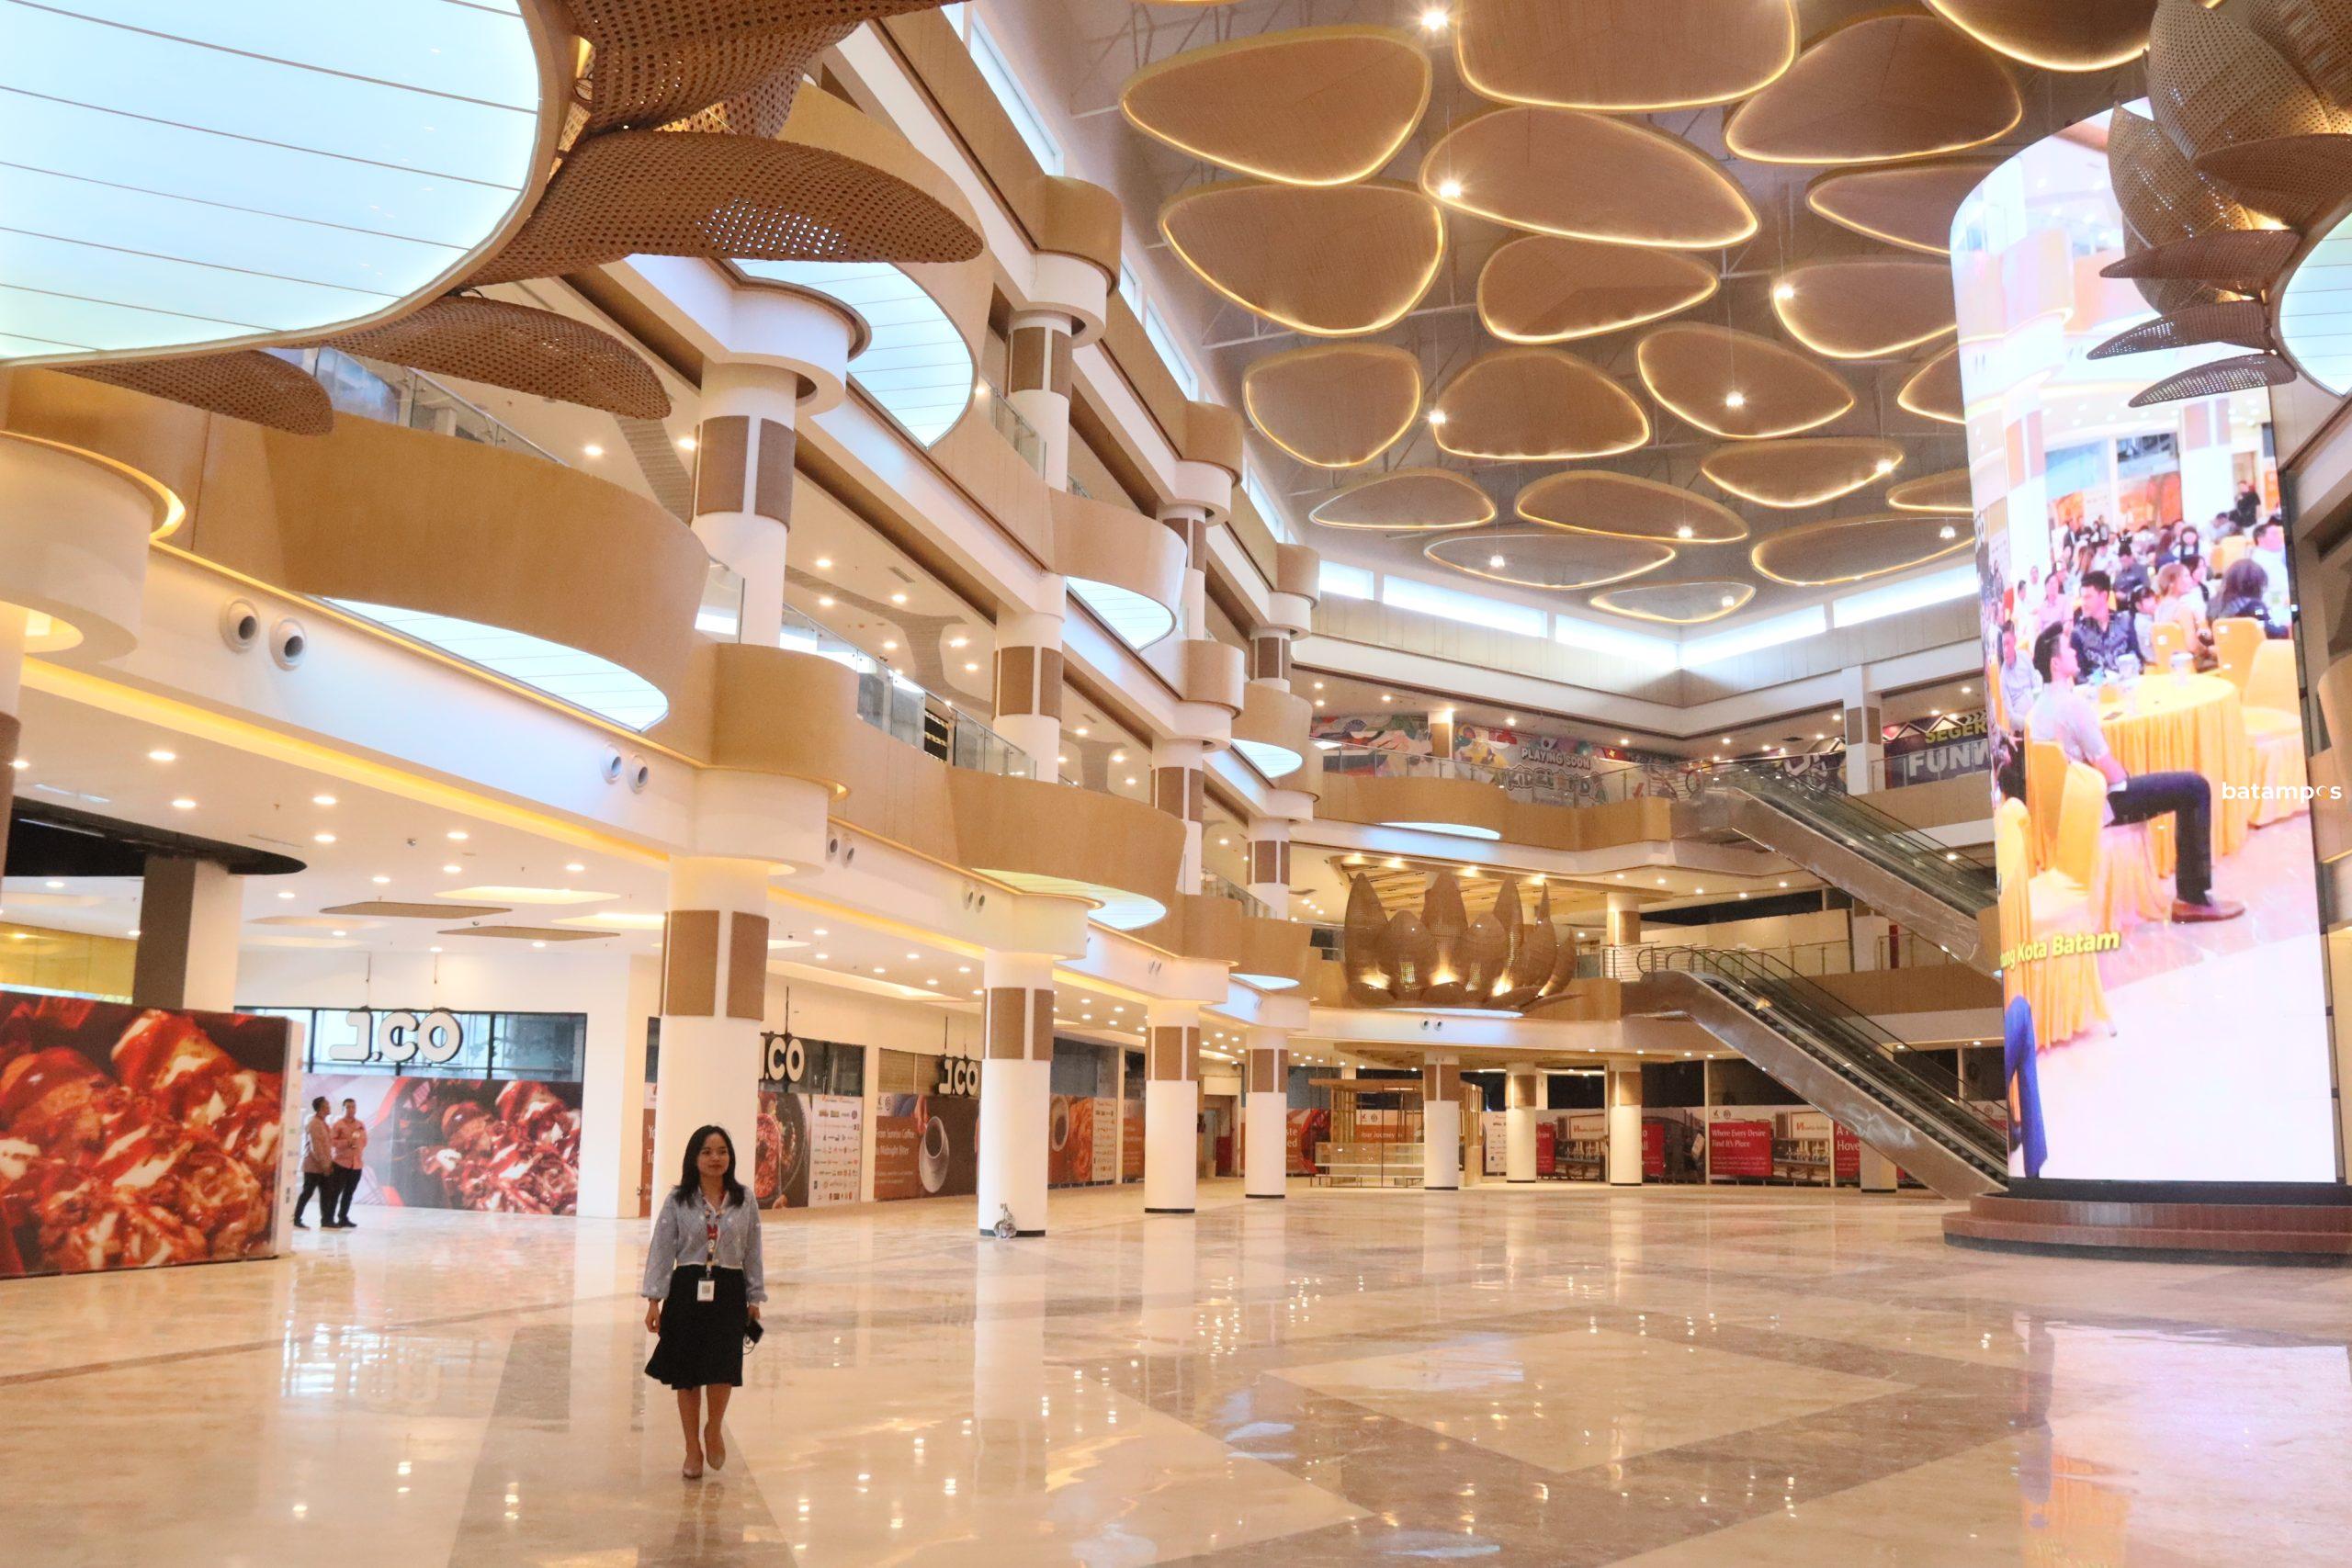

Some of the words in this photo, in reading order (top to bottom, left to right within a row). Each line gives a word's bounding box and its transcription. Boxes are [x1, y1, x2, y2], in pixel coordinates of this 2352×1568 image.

[1521, 747, 1564, 765] PLAYING
[1566, 753, 1591, 771] SOON
[2018, 941, 2048, 964] Kota
[2052, 931, 2121, 957] Batam
[329, 1010, 463, 1063] J.CO
[939, 1058, 979, 1096] J.CO
[902, 1128, 916, 1139] Coffee
[1712, 1129, 1731, 1137] Where
[1731, 1128, 1747, 1138] Every
[1747, 1129, 1766, 1137] Desire
[1712, 1139, 1724, 1147] Find
[1735, 1139, 1750, 1147] Place
